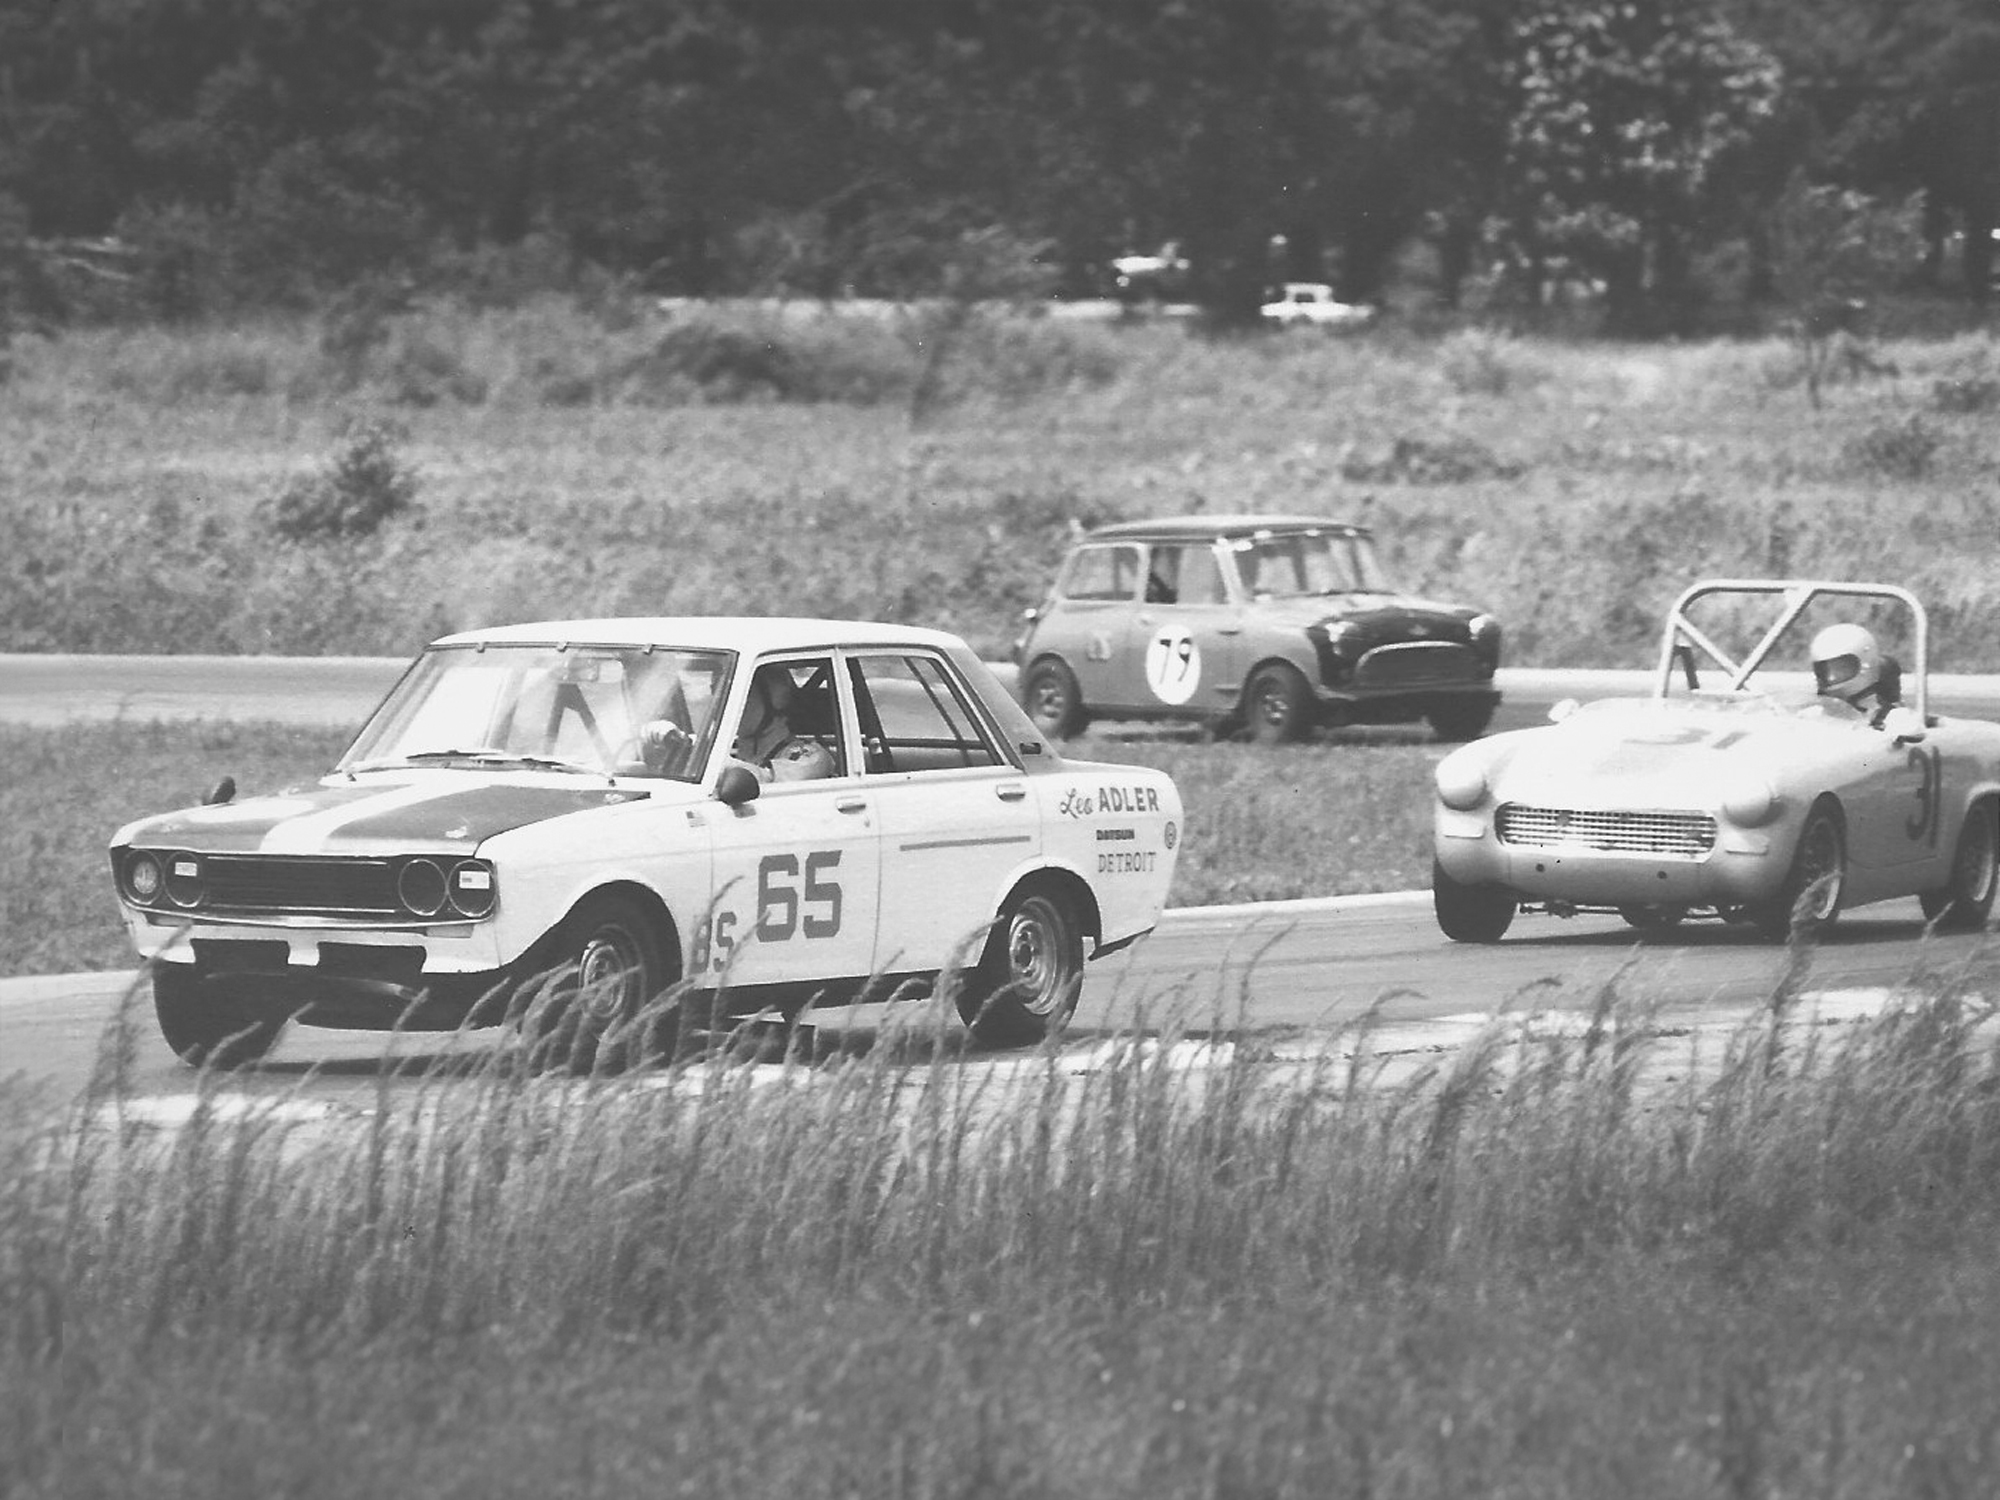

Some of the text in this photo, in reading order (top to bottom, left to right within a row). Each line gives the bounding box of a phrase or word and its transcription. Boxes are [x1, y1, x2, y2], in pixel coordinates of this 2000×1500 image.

[1159, 637, 1193, 684] 79
[1099, 787, 1160, 813] ADLER
[1904, 745, 1943, 850] 31
[1098, 851, 1157, 874] DETROIT
[756, 850, 843, 943] 65
